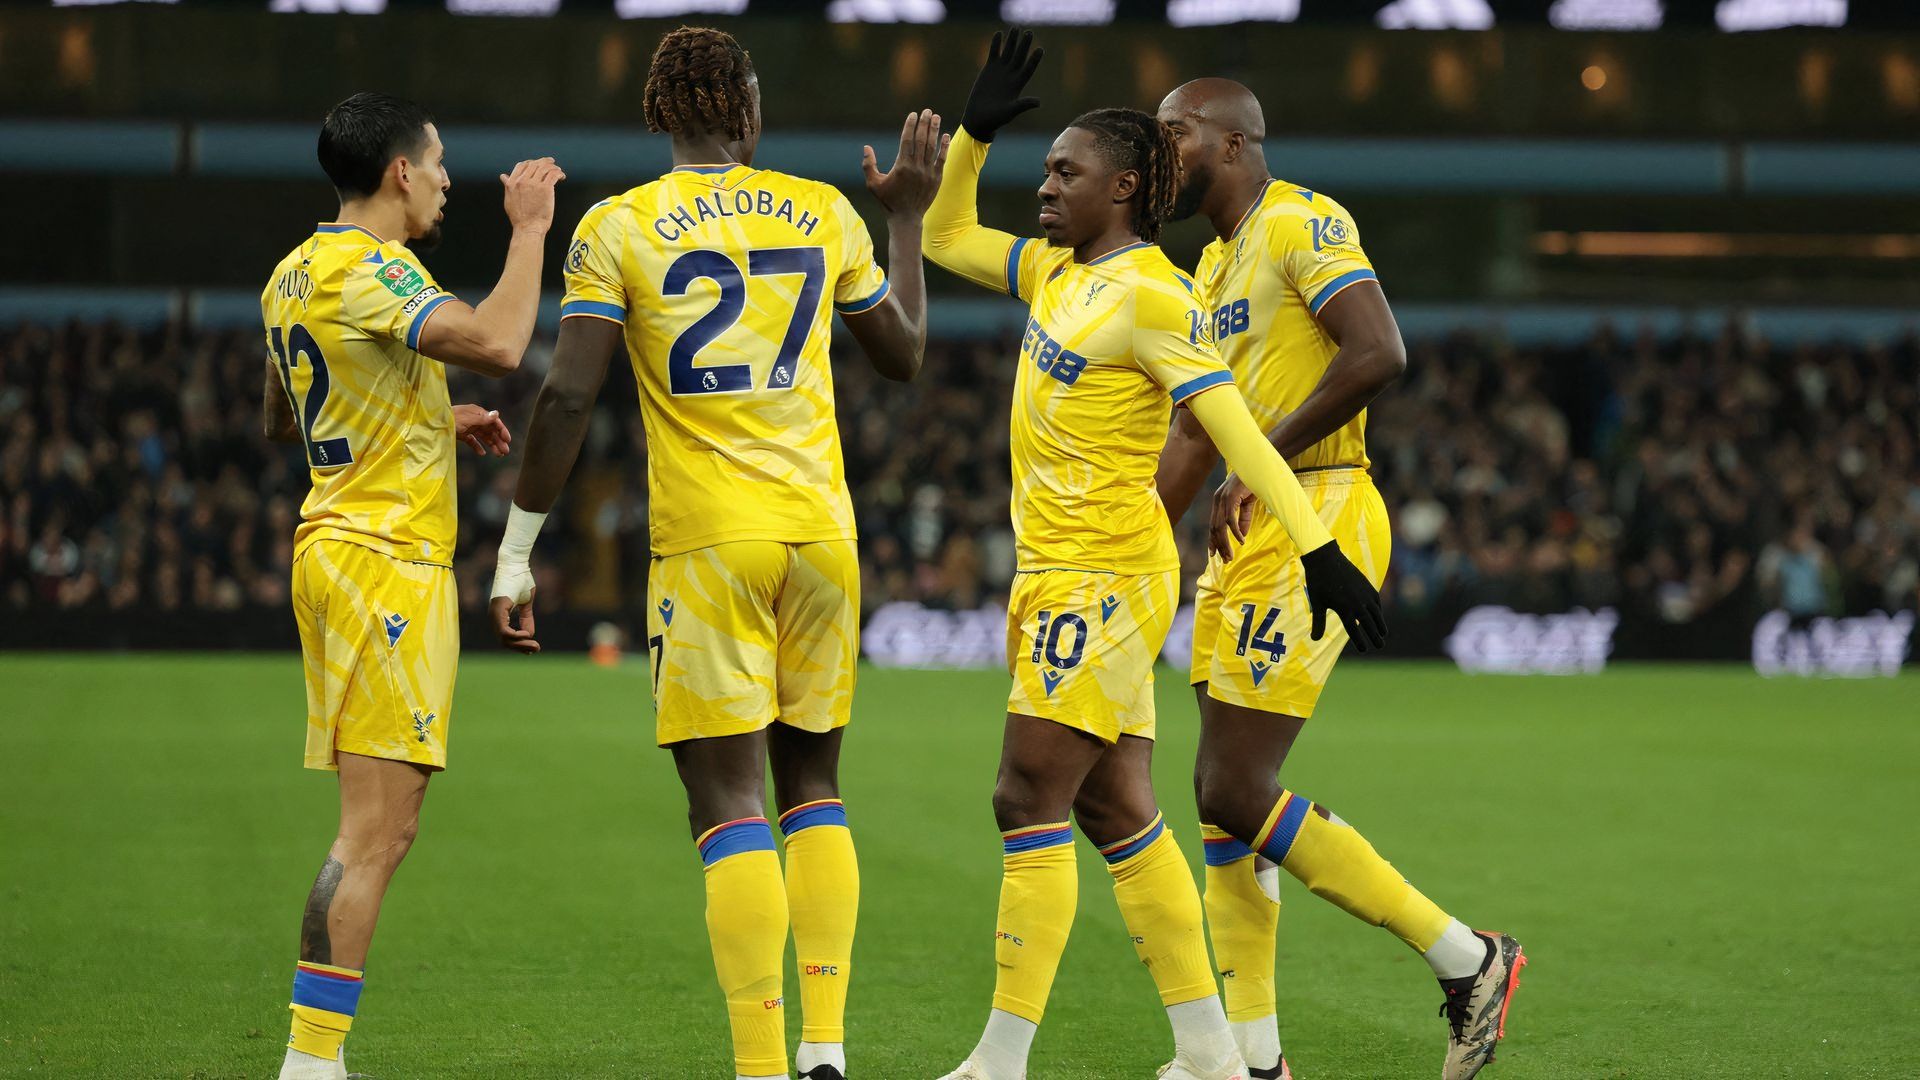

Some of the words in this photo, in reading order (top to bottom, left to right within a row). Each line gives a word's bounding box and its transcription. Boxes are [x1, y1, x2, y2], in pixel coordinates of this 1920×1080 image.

[653, 189, 821, 242] CHALOBAH
[402, 302, 416, 315] No
[414, 287, 438, 304] room
[661, 246, 827, 396] 27
[1023, 316, 1088, 385] ET88
[268, 323, 354, 468] 12
[1031, 610, 1088, 669] 10
[1235, 603, 1287, 663] 14
[649, 634, 663, 696] 7
[996, 931, 1023, 947] PFC
[805, 965, 838, 976] CPFC
[764, 996, 784, 1010] CPF
